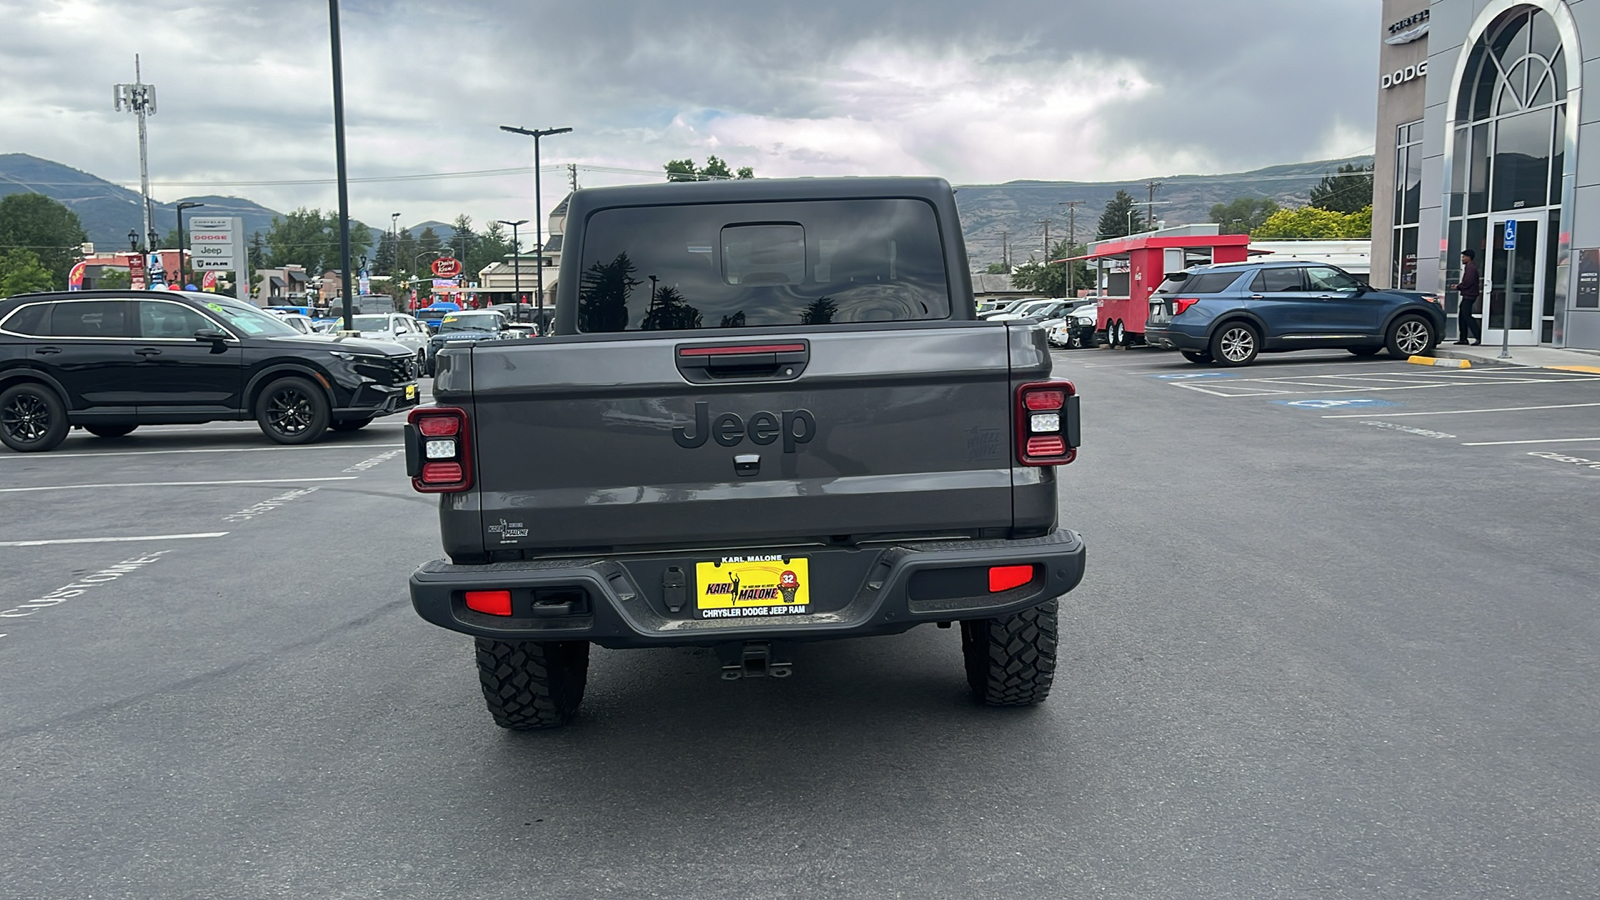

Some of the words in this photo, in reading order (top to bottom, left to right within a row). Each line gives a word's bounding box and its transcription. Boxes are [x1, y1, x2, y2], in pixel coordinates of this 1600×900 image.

[200, 246, 222, 255] Jeep
[672, 401, 816, 454] Jeep
[783, 574, 794, 583] 32
[705, 583, 733, 595] KARL
[738, 588, 778, 601] MALONE
[702, 609, 741, 618] CHRYSLER
[742, 607, 769, 616] DODGE
[769, 606, 787, 615] JEEP
[788, 605, 805, 613] RAM
